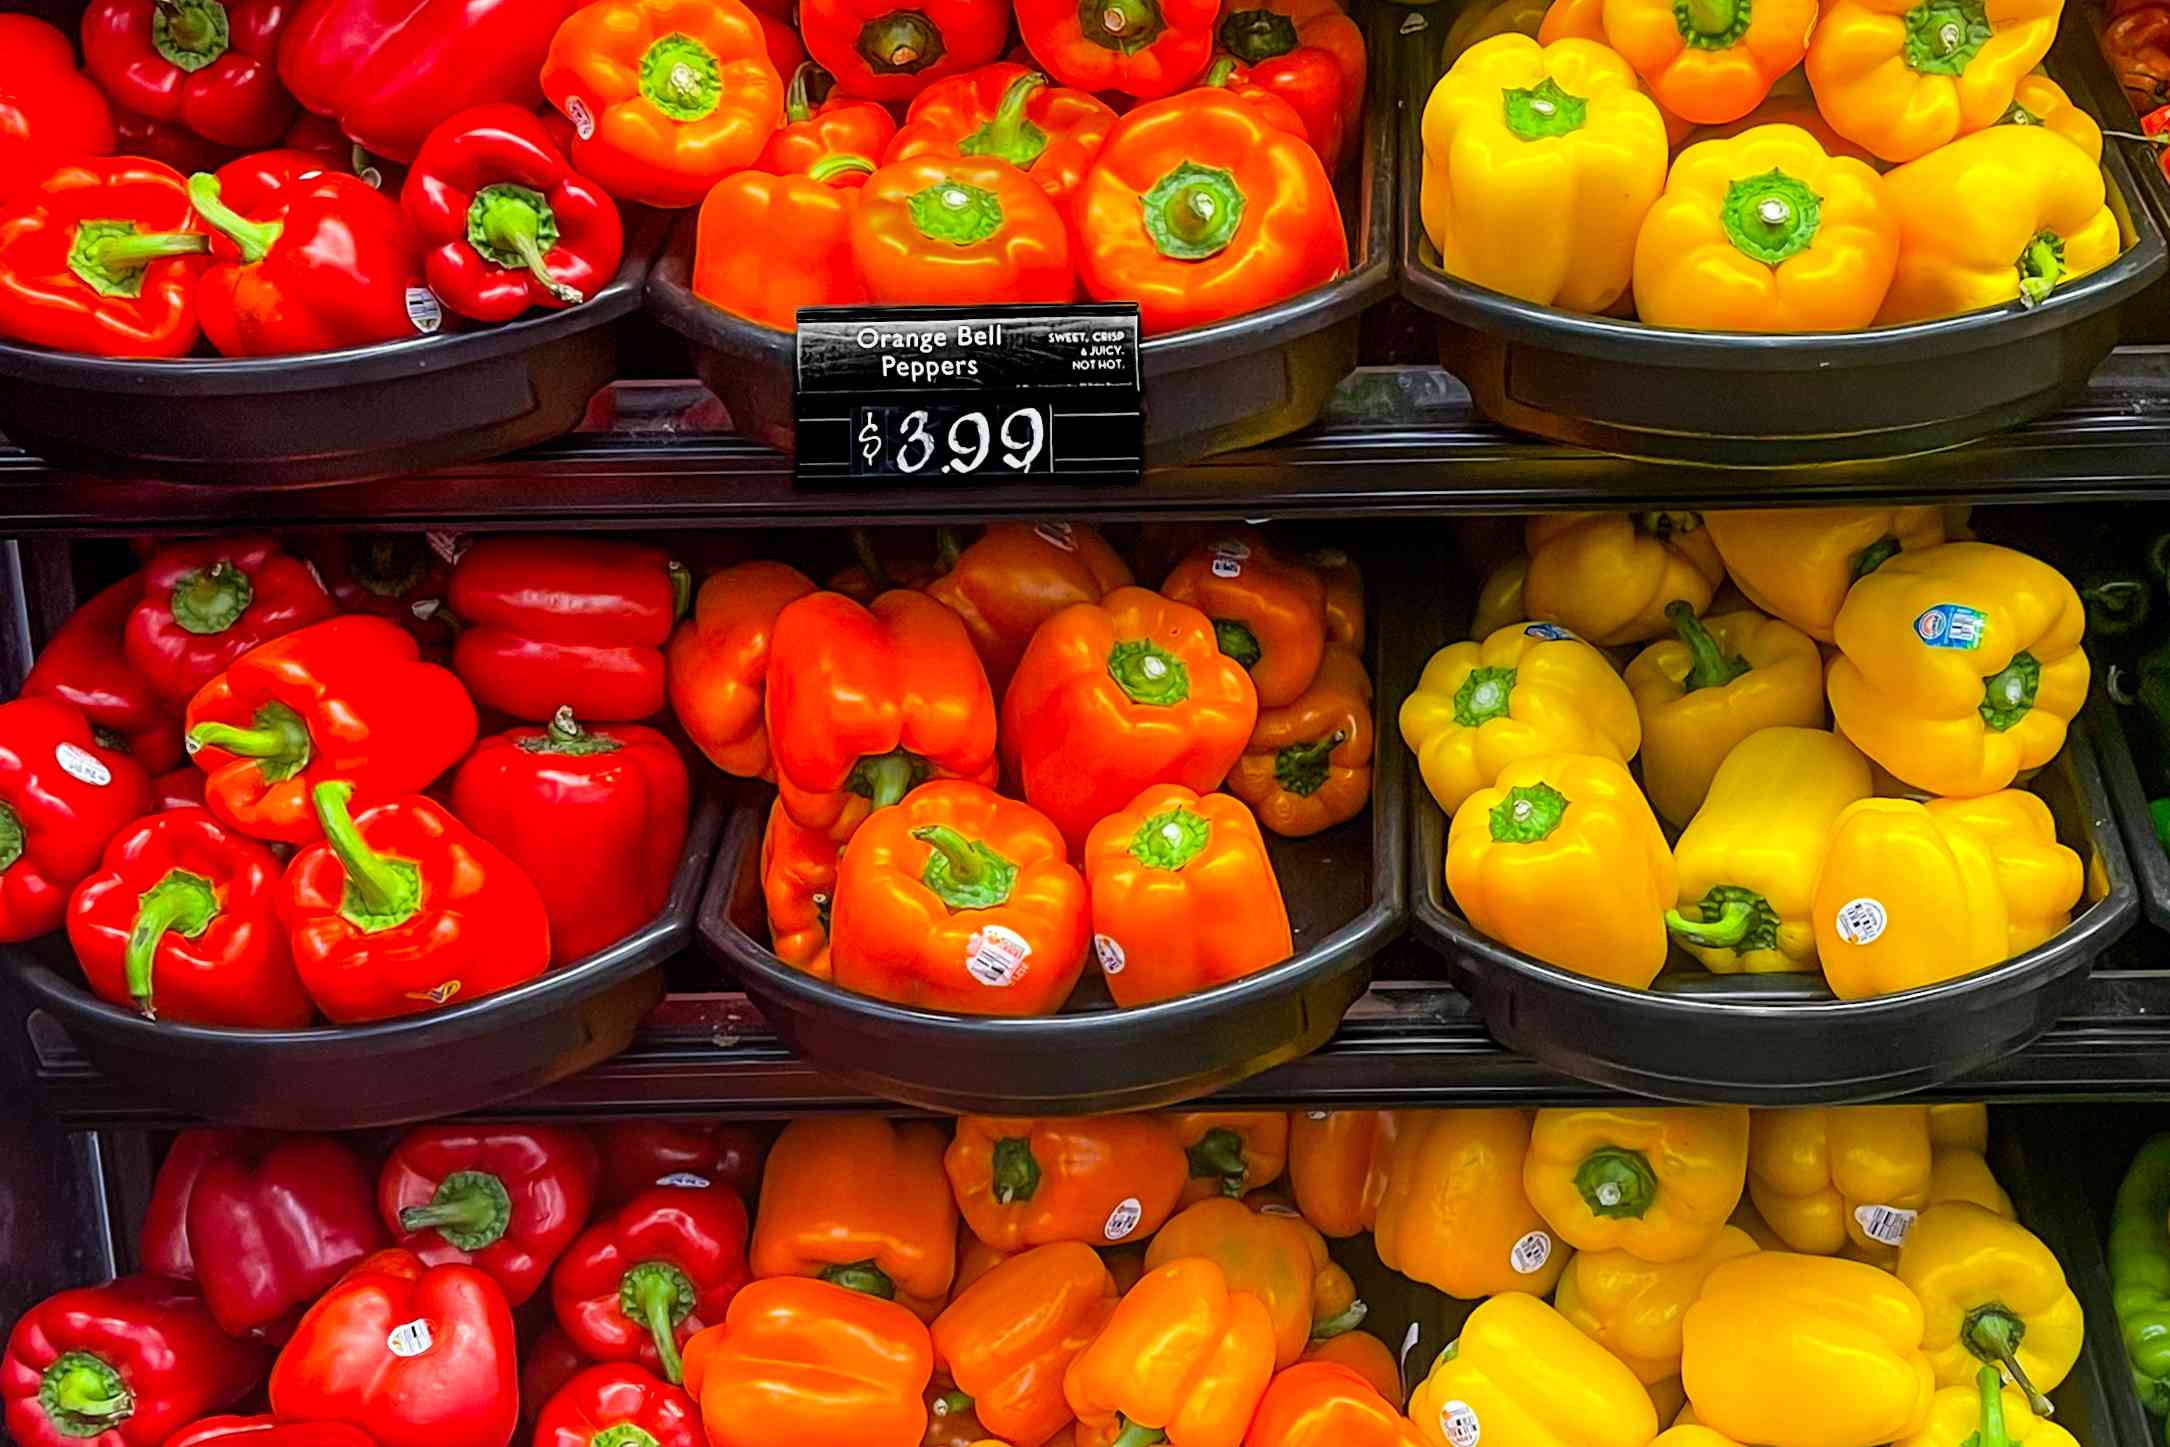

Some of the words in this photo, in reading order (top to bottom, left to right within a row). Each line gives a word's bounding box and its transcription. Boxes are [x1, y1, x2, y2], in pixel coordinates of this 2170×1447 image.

[856, 327, 948, 353] Orange
[958, 324, 1003, 347] Bell
[1092, 331, 1125, 343] CRISP
[882, 355, 980, 383] Peppers
[1072, 359, 1096, 371] NOT
